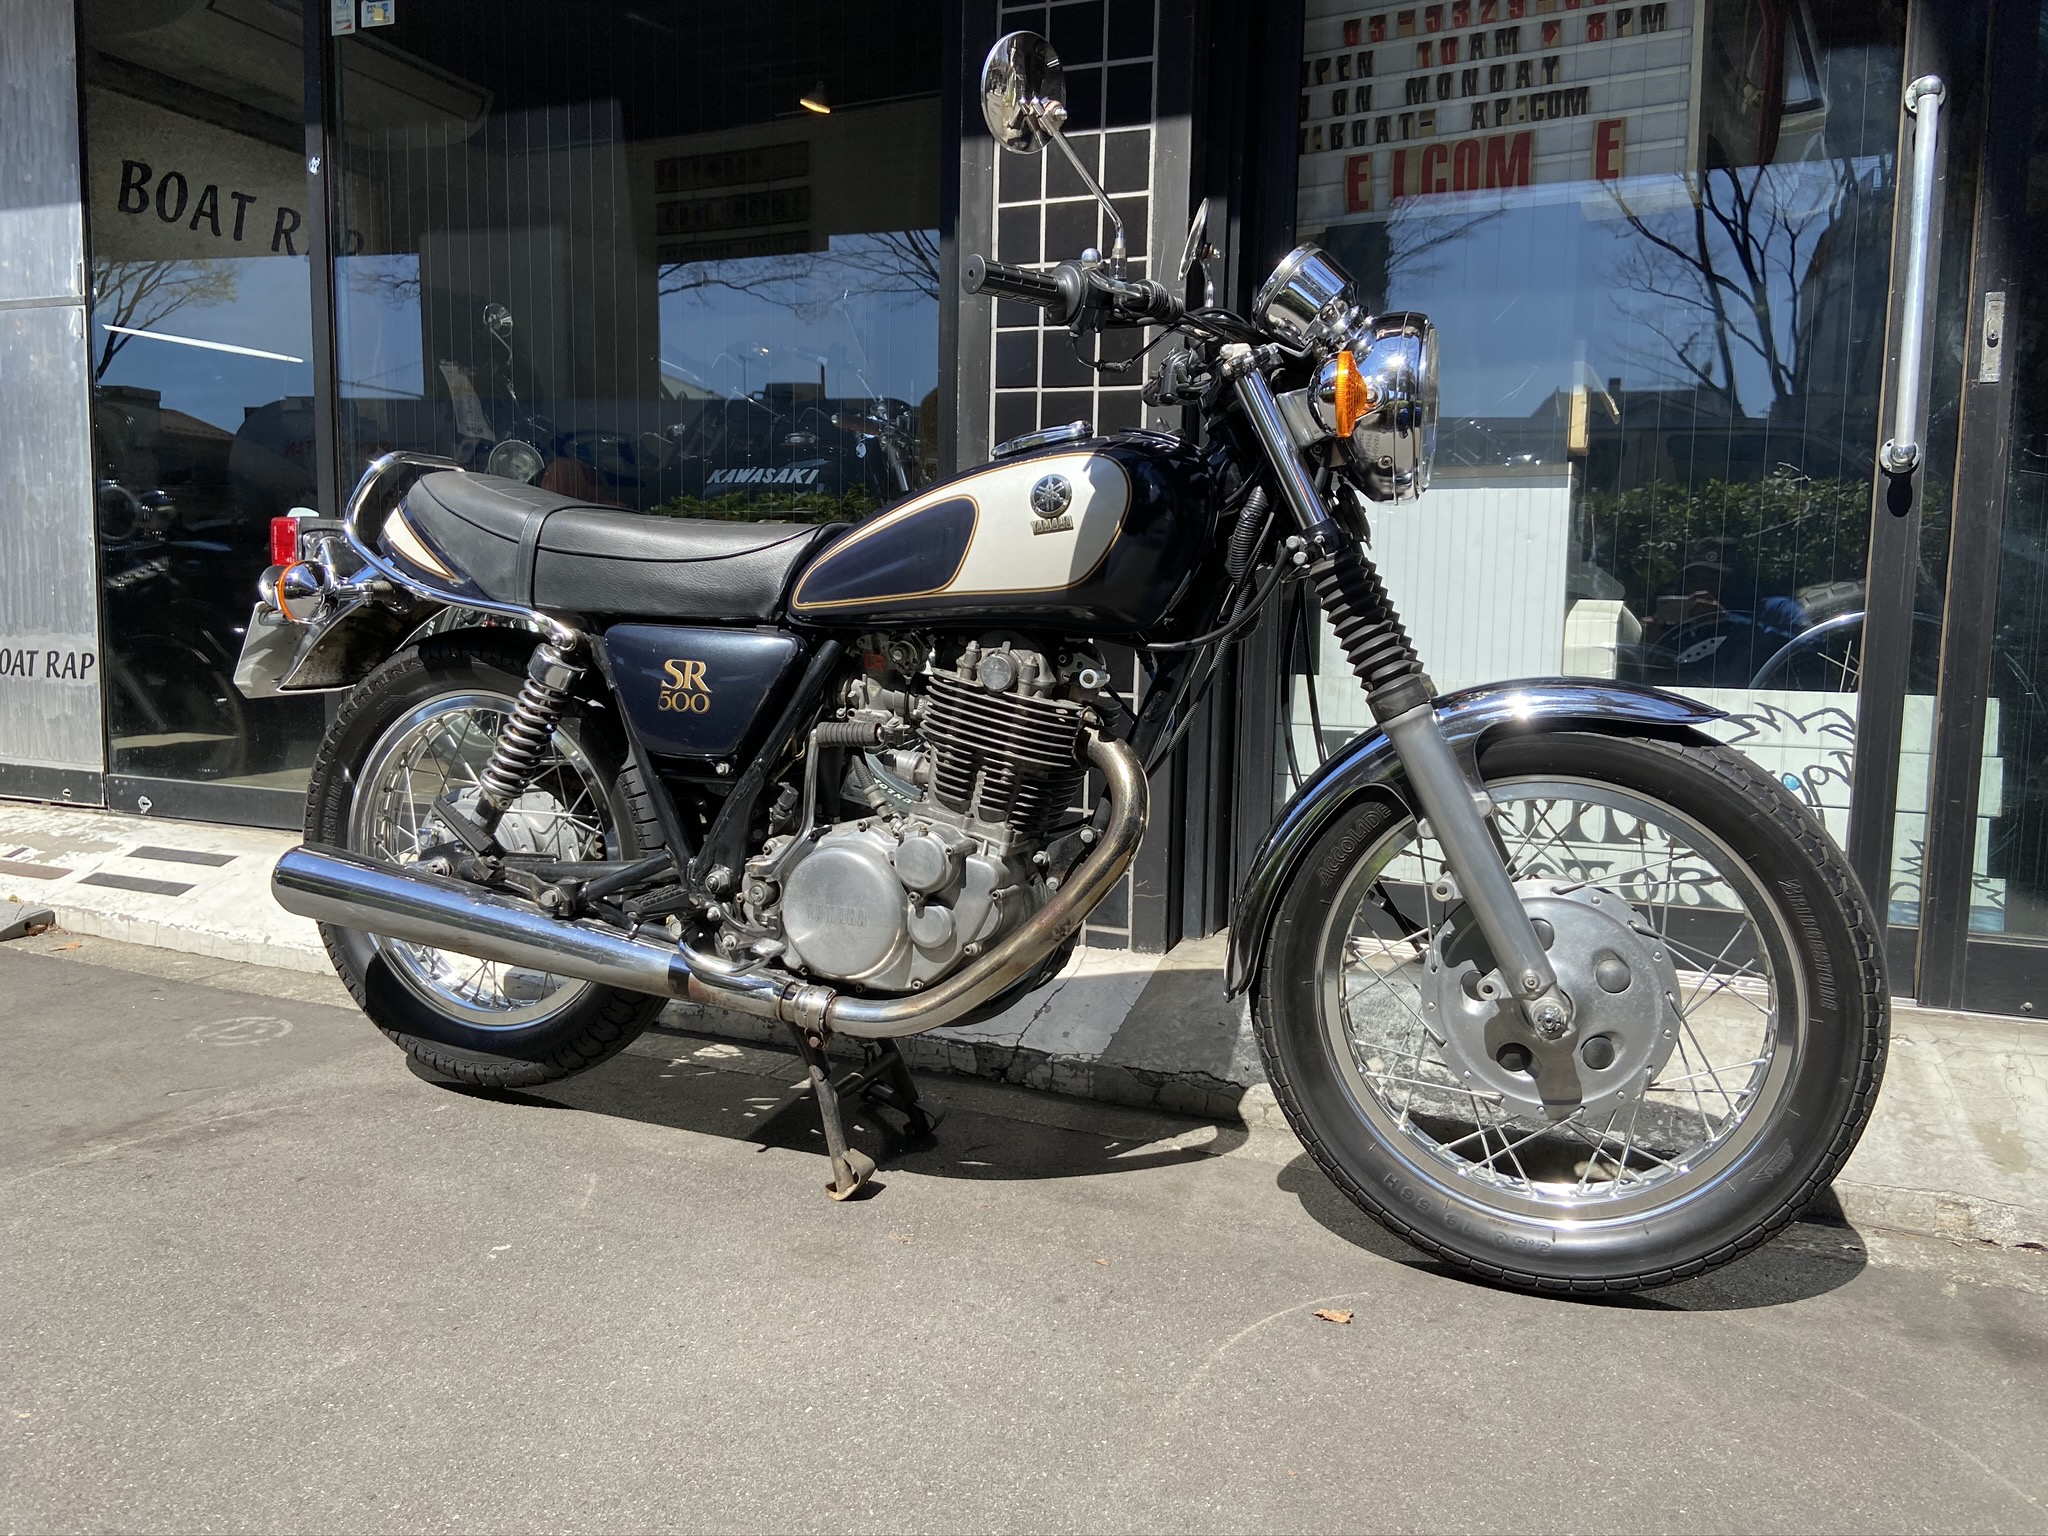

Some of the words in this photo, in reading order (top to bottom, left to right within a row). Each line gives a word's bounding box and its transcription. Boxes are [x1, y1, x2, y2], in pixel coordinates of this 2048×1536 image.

[1332, 84, 1373, 117] ON
[1405, 55, 1560, 106] MONDAY
[117, 159, 257, 242] BOAT
[706, 468, 820, 484] KAWASAKI
[1030, 515, 1075, 536] YAMAHA
[46, 650, 95, 680] RAP
[661, 659, 713, 694] SR
[658, 690, 711, 715] 500
[1318, 803, 1392, 888] ACCOLADE
[1777, 879, 1838, 1012] BRIDGESTONE
